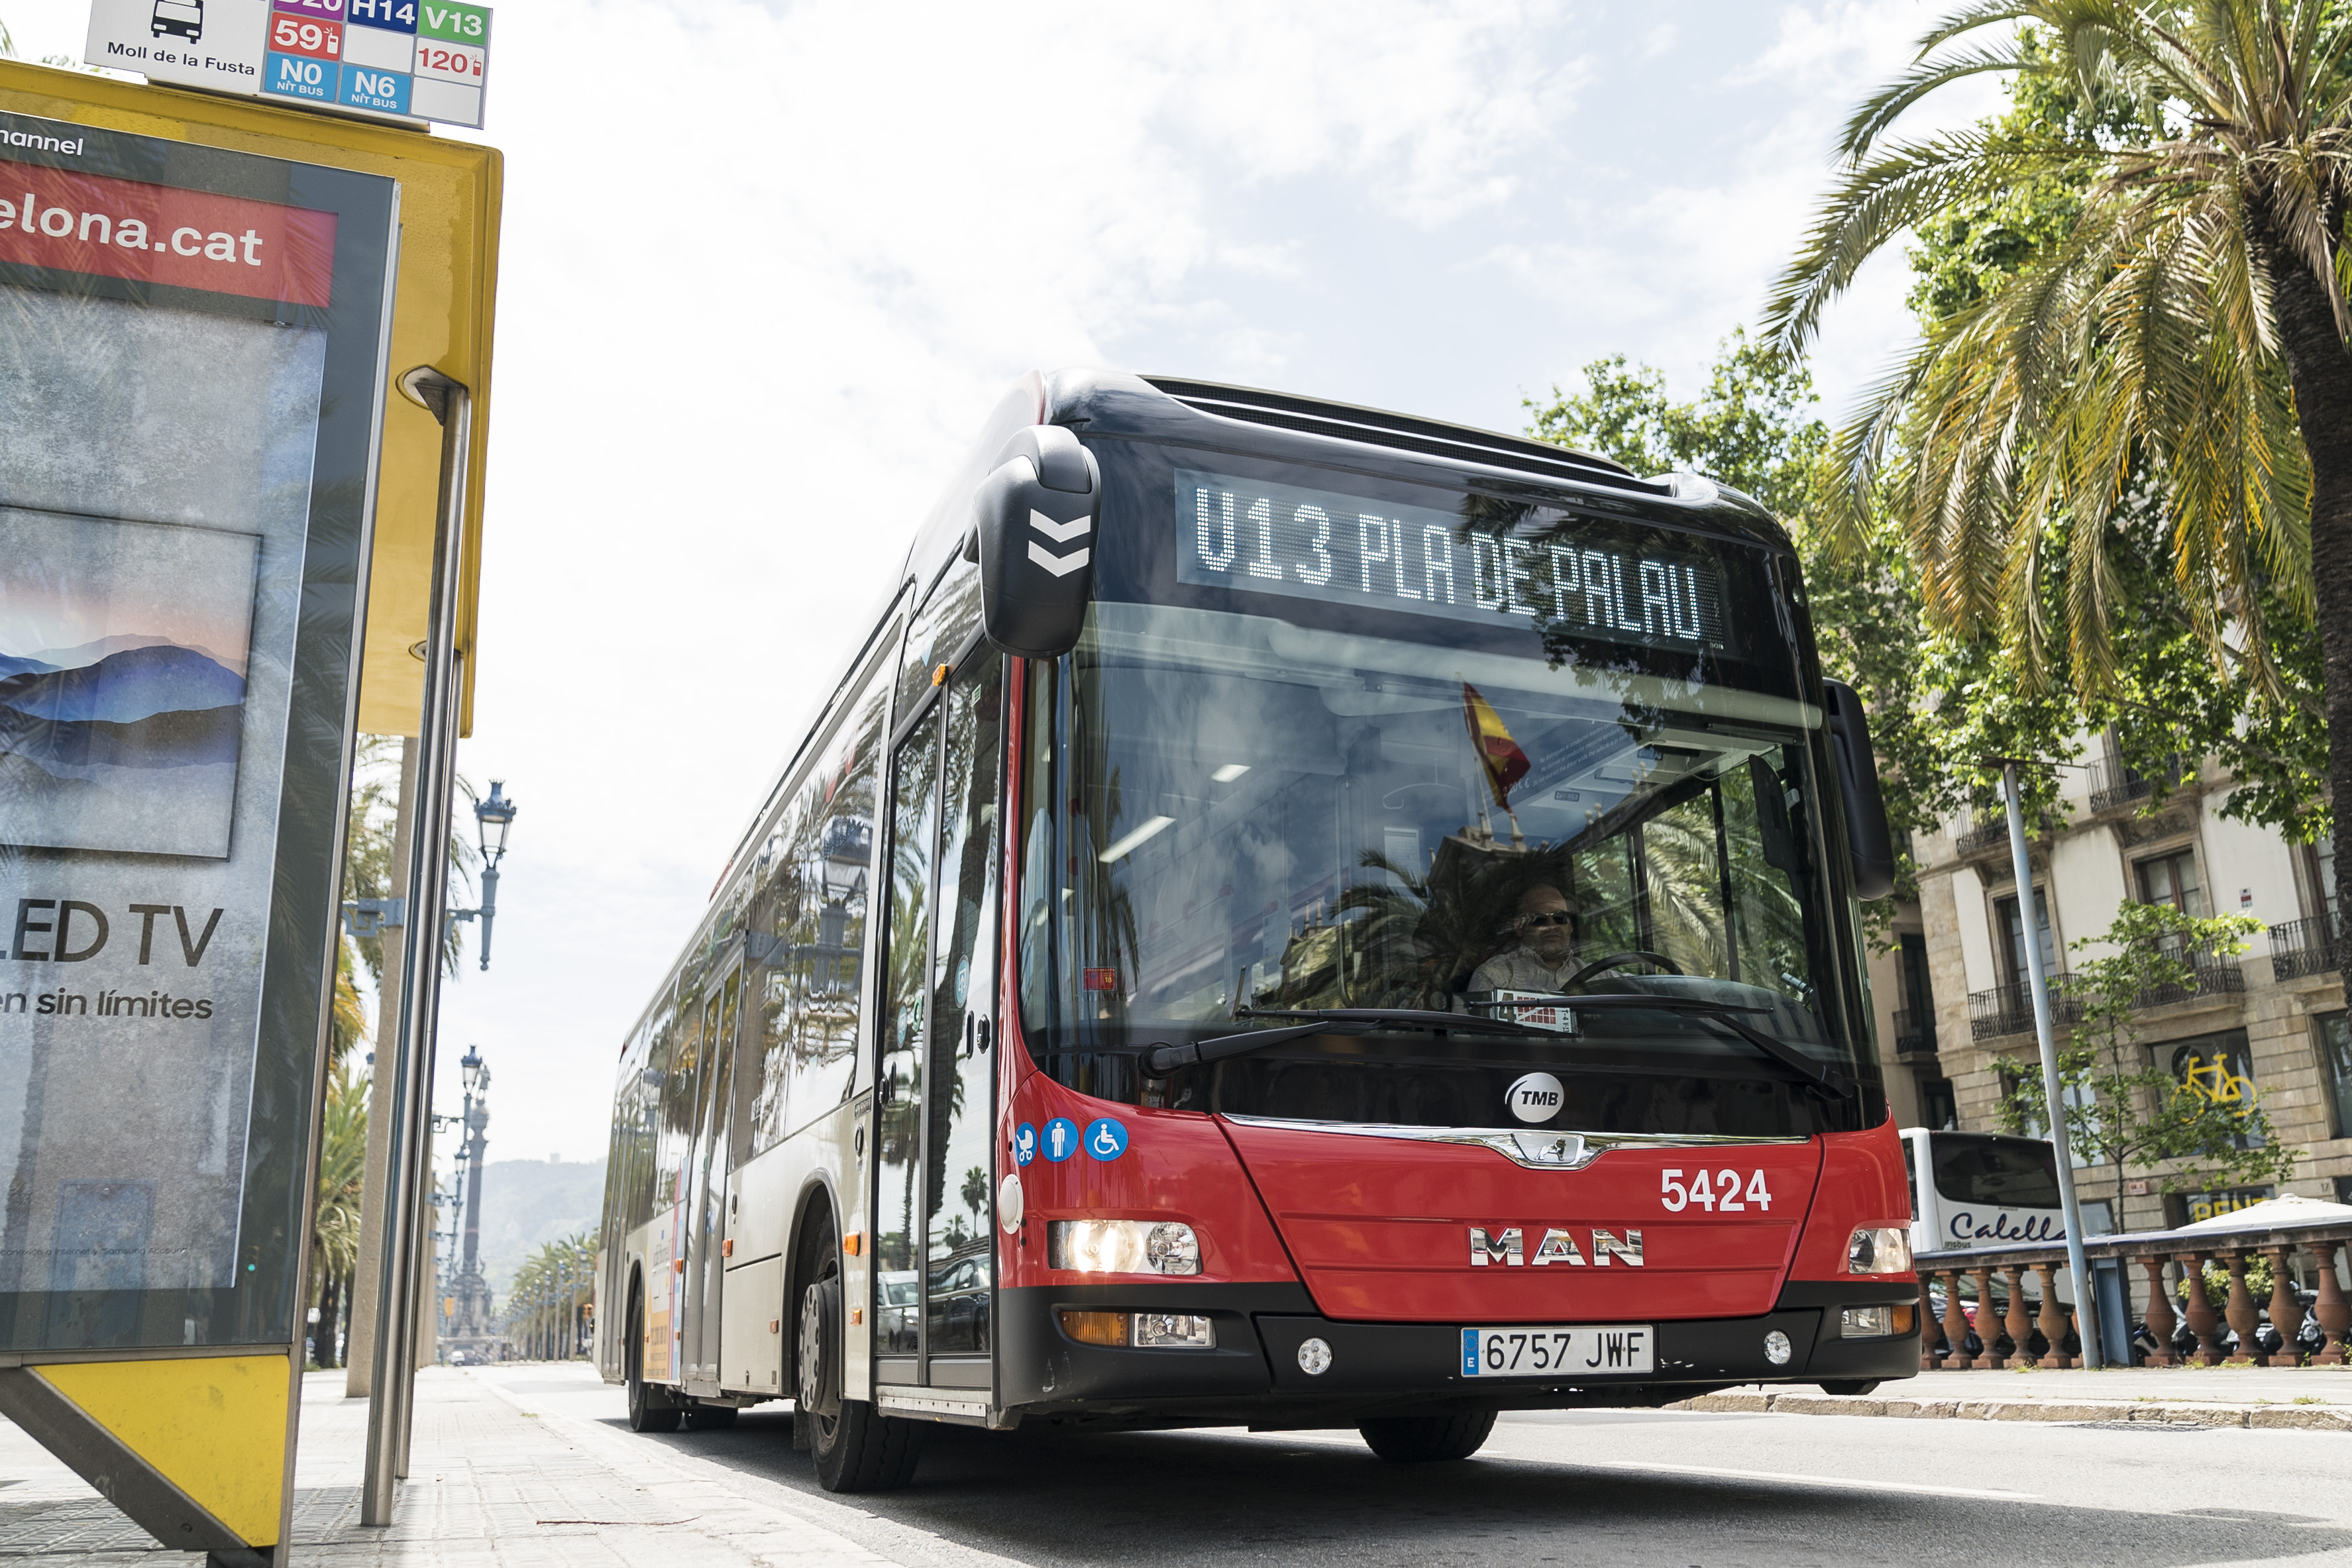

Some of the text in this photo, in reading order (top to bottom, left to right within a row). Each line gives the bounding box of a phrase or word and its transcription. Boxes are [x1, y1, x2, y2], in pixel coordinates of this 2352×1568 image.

[352, 0, 415, 25] H14
[425, 6, 483, 36] V13
[274, 19, 323, 50] 59
[107, 41, 255, 76] Moll de la Fusta
[280, 58, 323, 85] N0
[418, 47, 468, 74] 120
[298, 84, 324, 96] BUS
[354, 71, 396, 98] N6
[372, 97, 398, 109] BUS
[1359, 513, 1454, 604] PLA
[1471, 531, 1536, 617] DE
[1550, 545, 1701, 641] PALAU
[0, 898, 225, 967] ED TV
[0, 987, 214, 1019] n sin límites
[1521, 1090, 1559, 1106] TMB
[1661, 1169, 1772, 1212] 5424
[1469, 1227, 1644, 1267] MAN
[1467, 1332, 1644, 1370] E 6757 JWF
